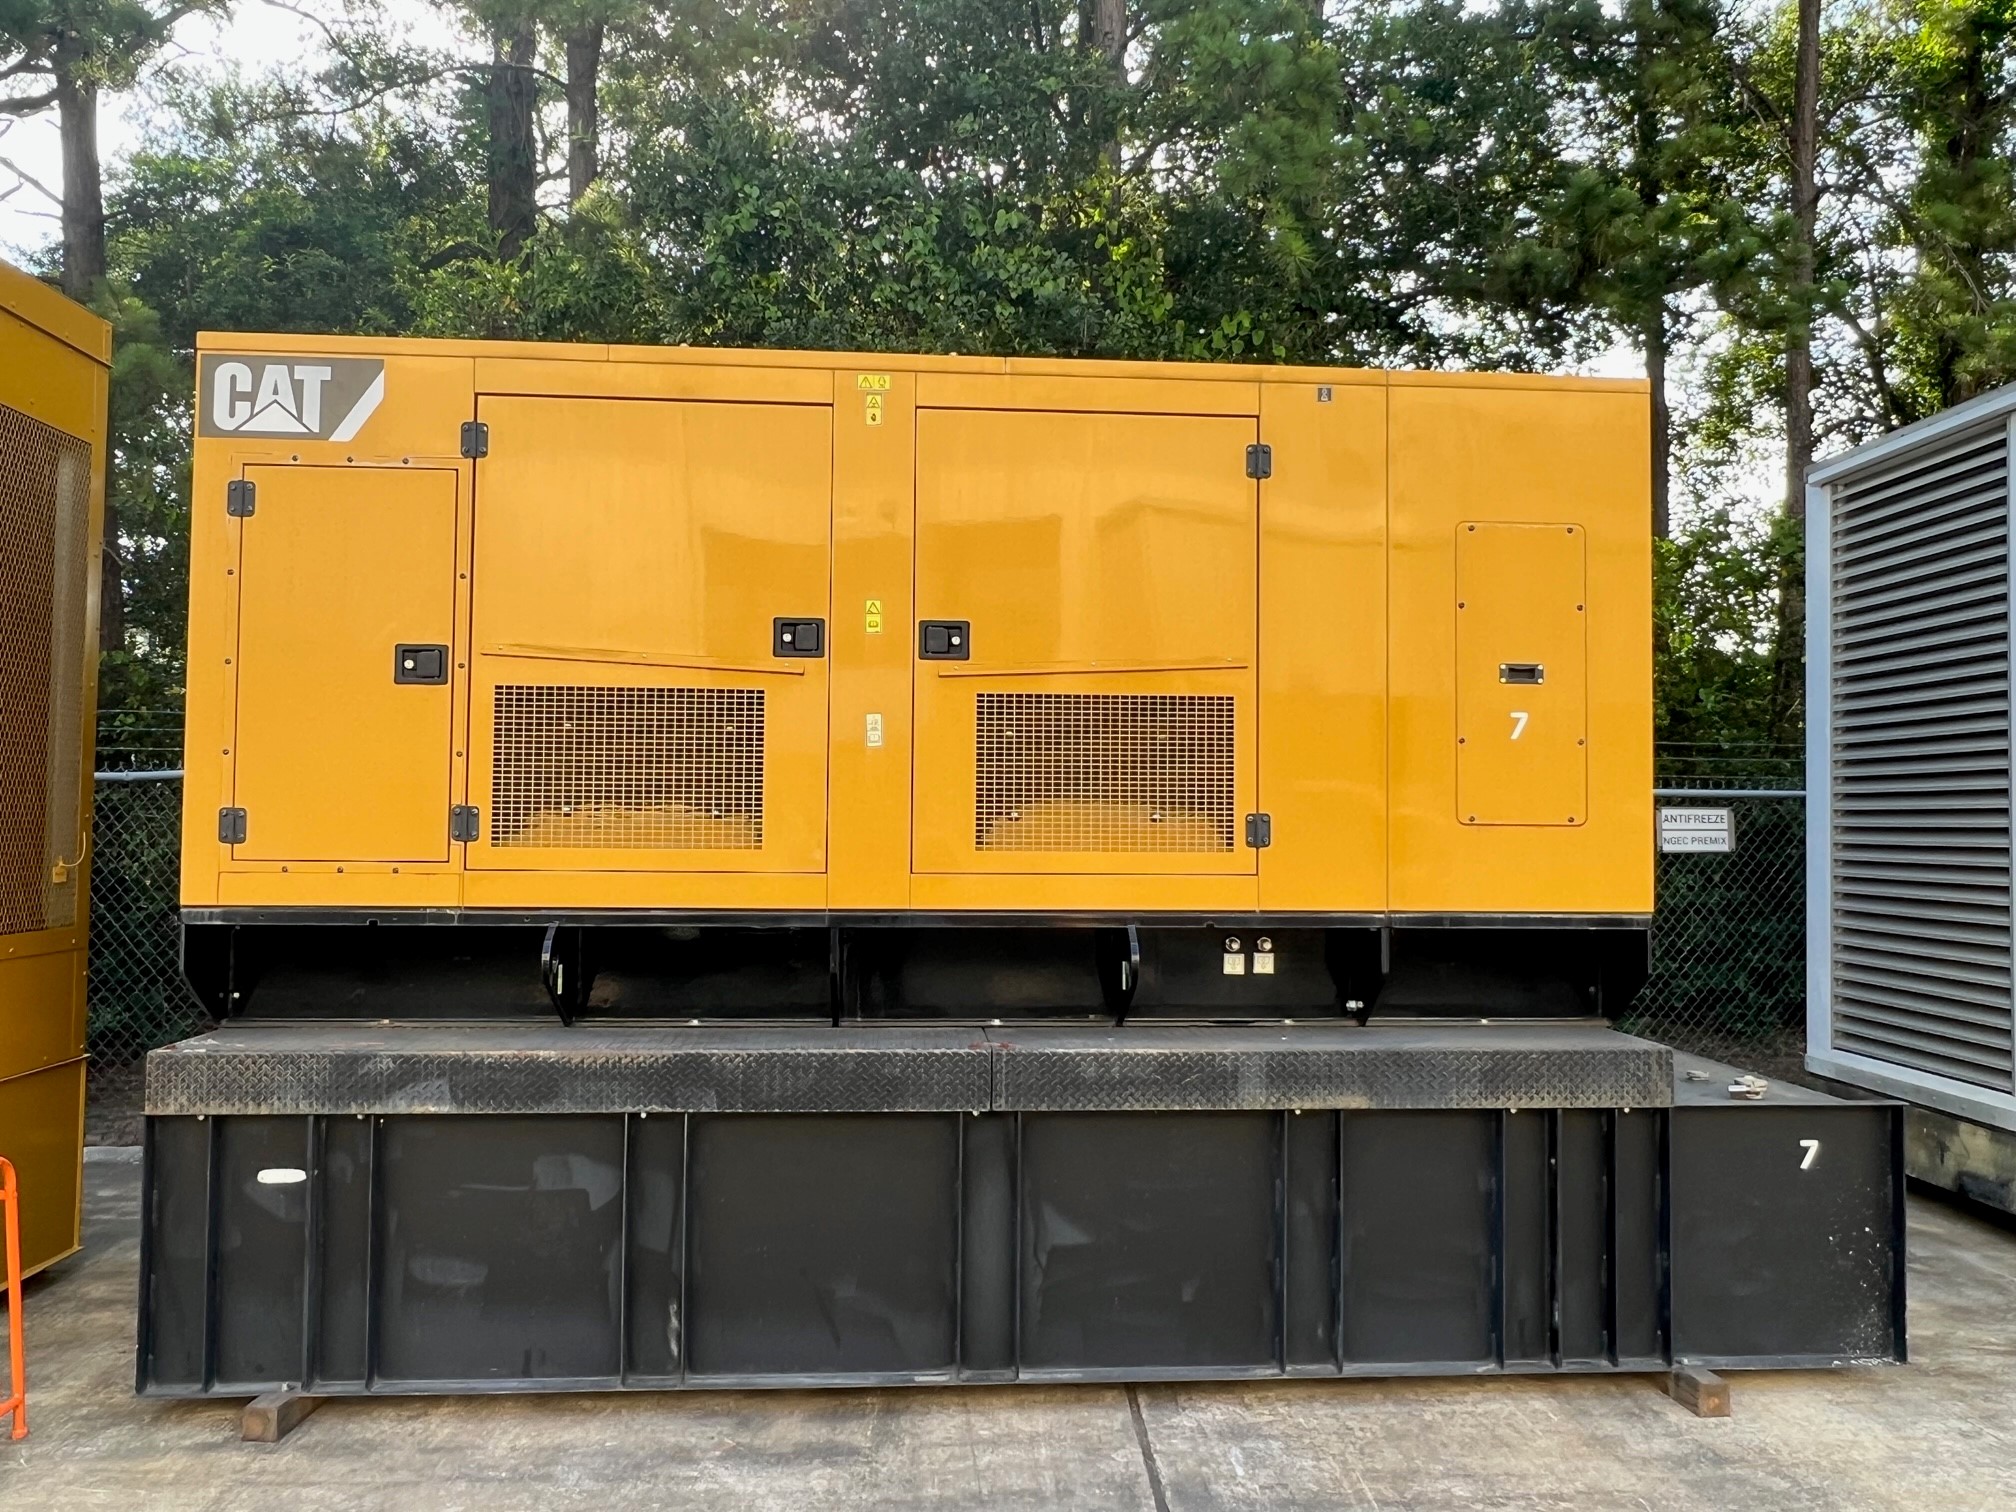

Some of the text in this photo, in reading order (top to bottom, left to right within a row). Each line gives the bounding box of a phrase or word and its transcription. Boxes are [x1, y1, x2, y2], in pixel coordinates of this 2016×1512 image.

[213, 362, 331, 433] CAT
[1509, 711, 1529, 740] 7
[1662, 814, 1726, 824] ANTIFREEZE
[1691, 836, 1727, 845] PREMIX
[1799, 1139, 1819, 1170] 7
